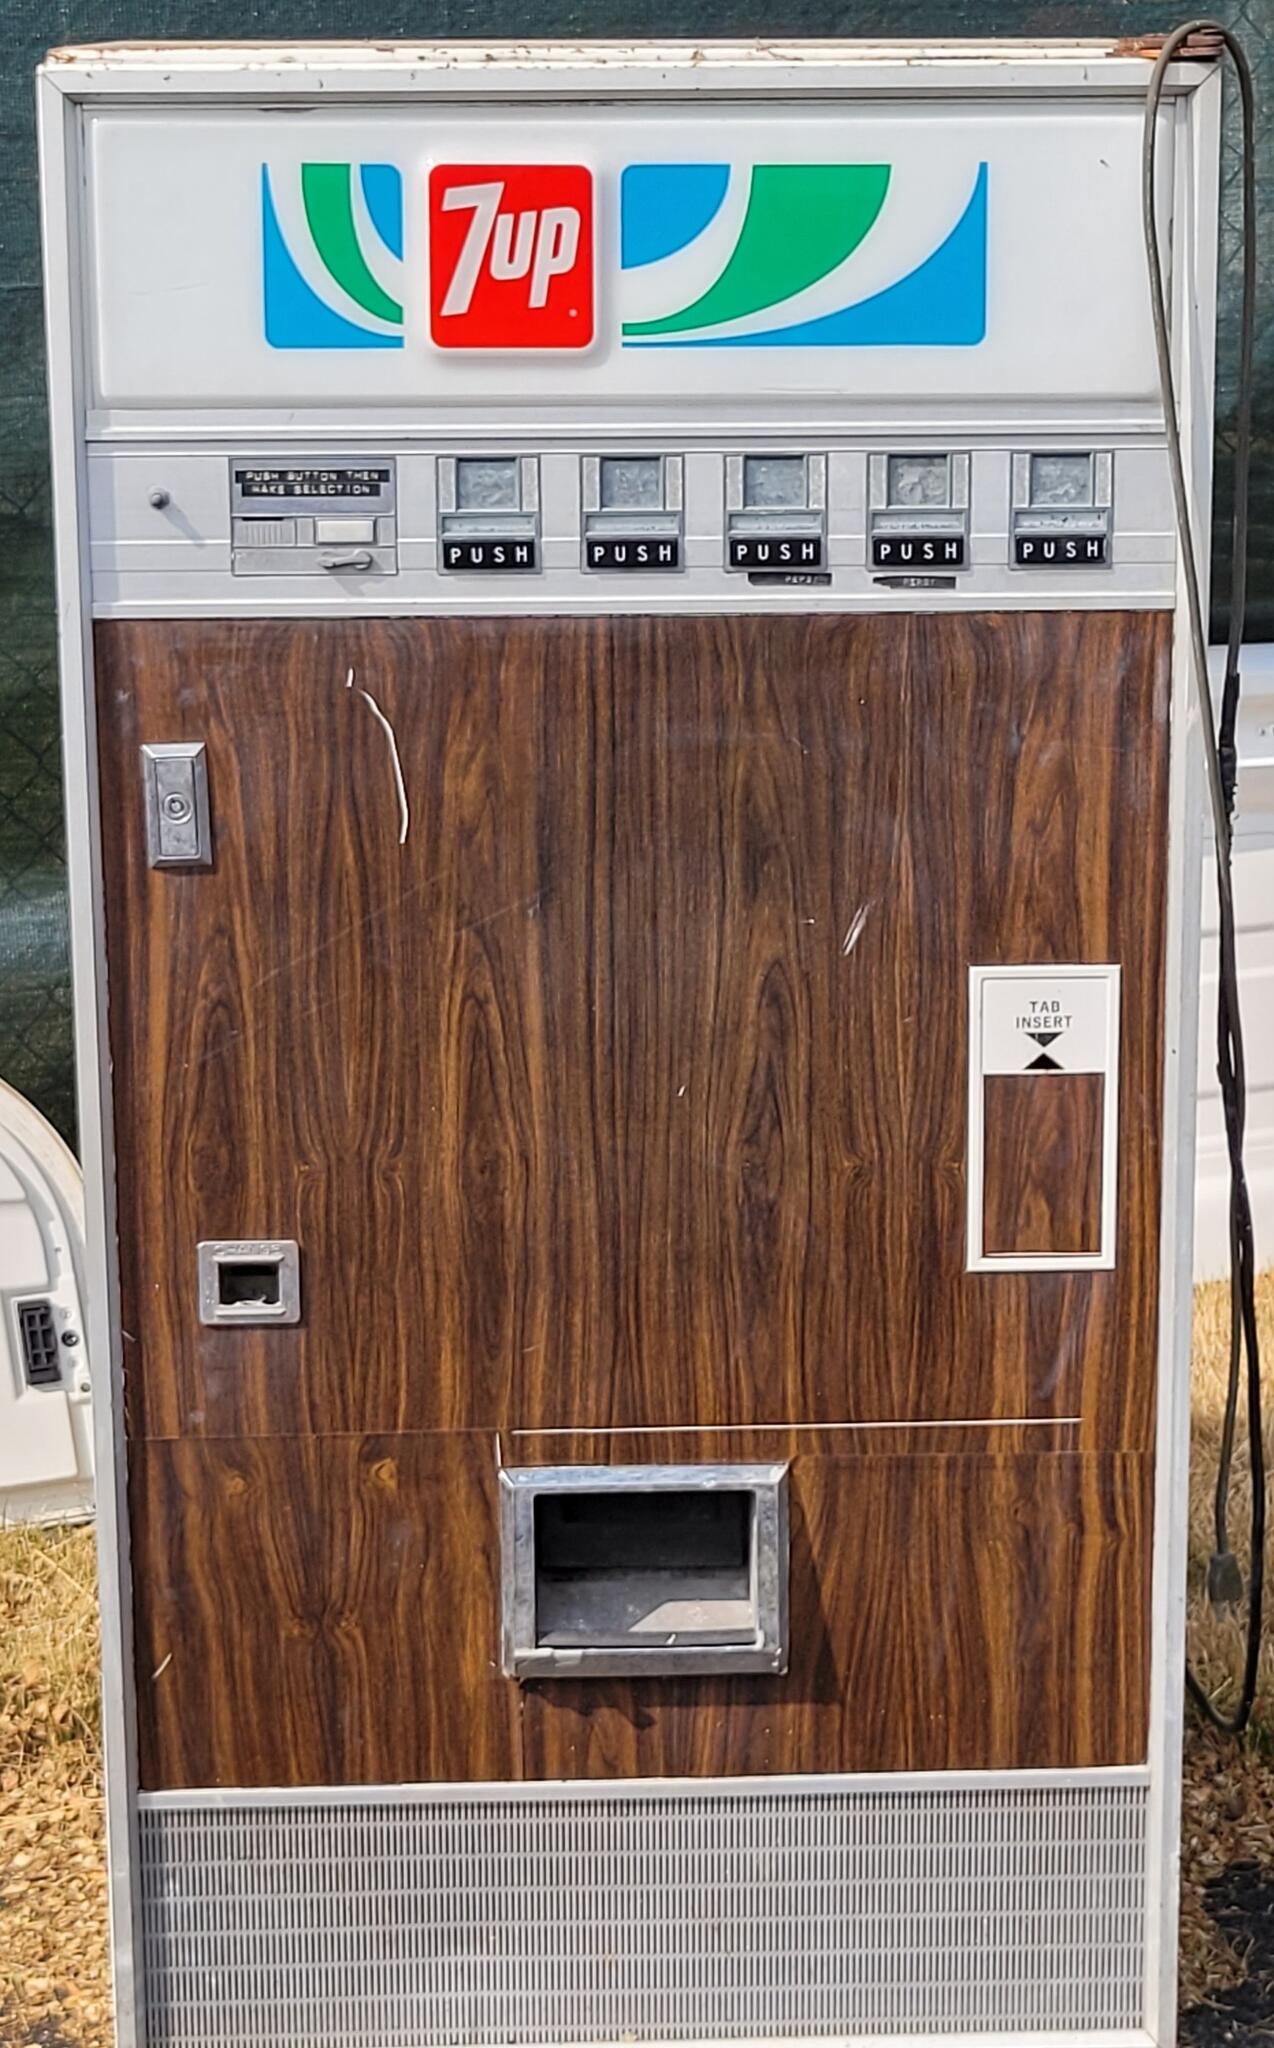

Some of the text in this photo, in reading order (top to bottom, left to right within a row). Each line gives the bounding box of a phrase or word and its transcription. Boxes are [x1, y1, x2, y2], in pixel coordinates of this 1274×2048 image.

[245, 470, 379, 481] PUSH BUTTON THEN
[251, 484, 370, 494] MAKE SELECTION
[450, 545, 528, 564] PUSH
[593, 544, 672, 563] PUSH
[736, 543, 815, 561] PUSH
[879, 542, 957, 560] PUSH
[1022, 541, 1099, 559] PUSH
[1029, 1000, 1061, 1014] TAB
[1015, 1015, 1073, 1029] INSERT
